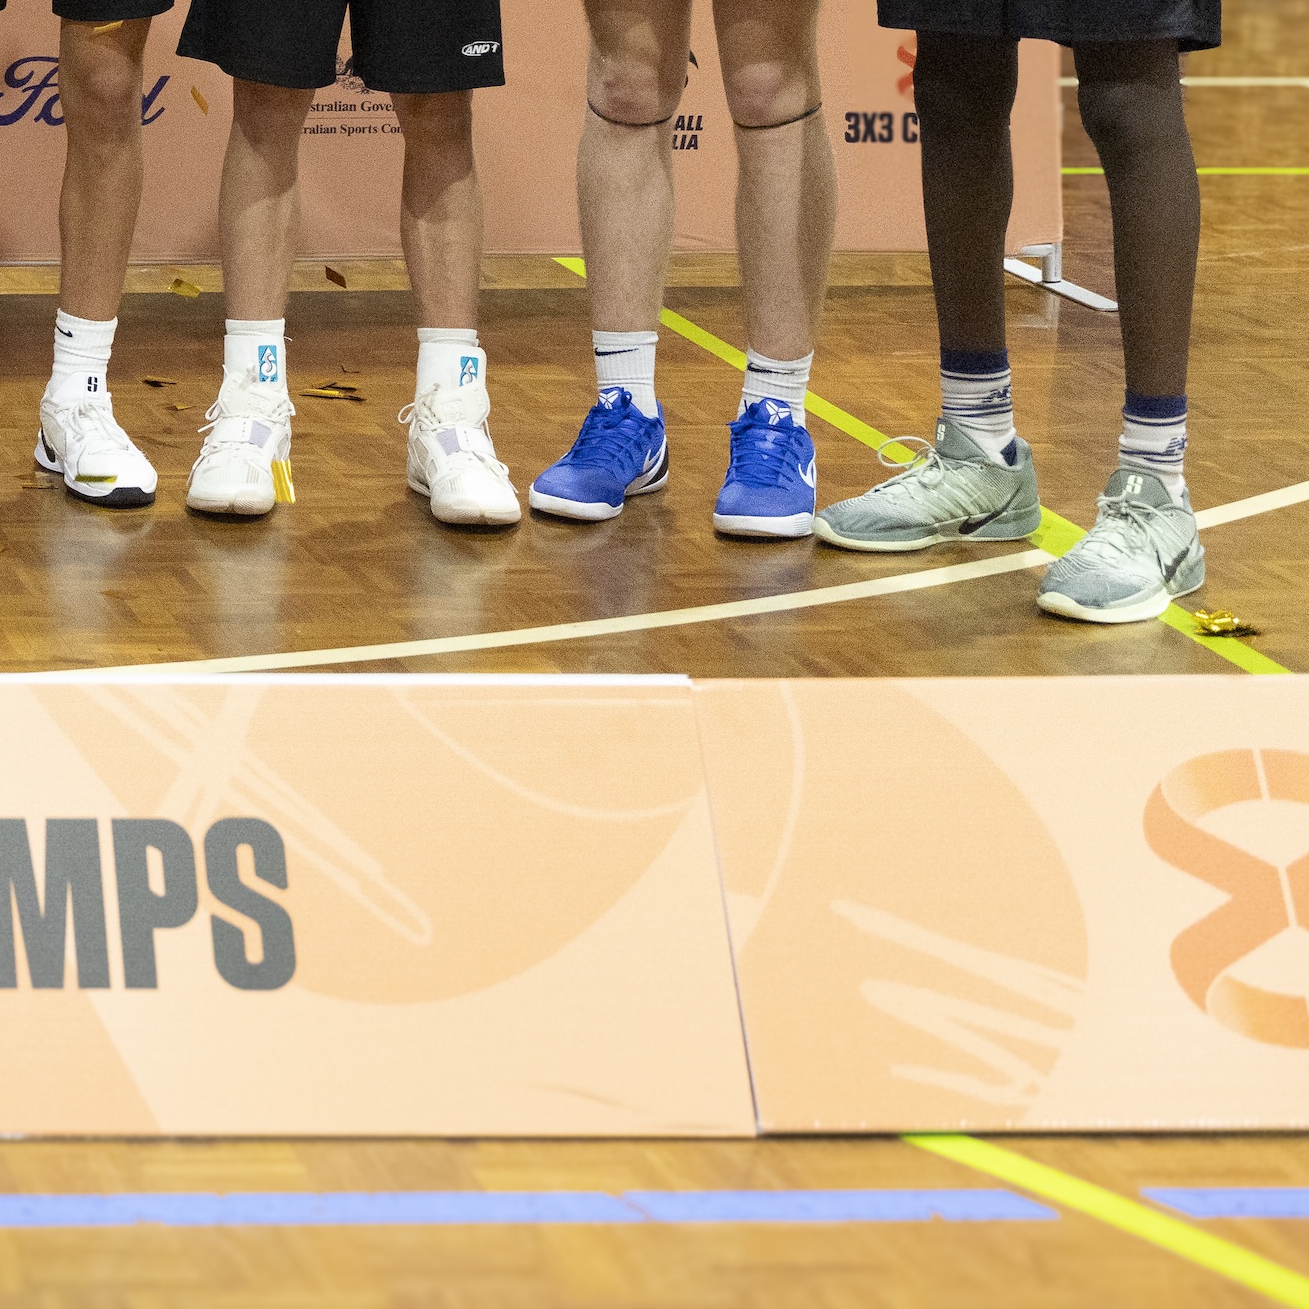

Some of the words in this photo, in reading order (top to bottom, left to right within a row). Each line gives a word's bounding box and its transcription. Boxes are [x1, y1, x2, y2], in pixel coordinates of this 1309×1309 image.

[464, 43, 491, 54] AND
[491, 43, 498, 53] 1
[310, 101, 357, 112] stralian
[303, 124, 337, 135] ralian
[339, 123, 378, 137] Sports
[844, 112, 894, 143] 3X3
